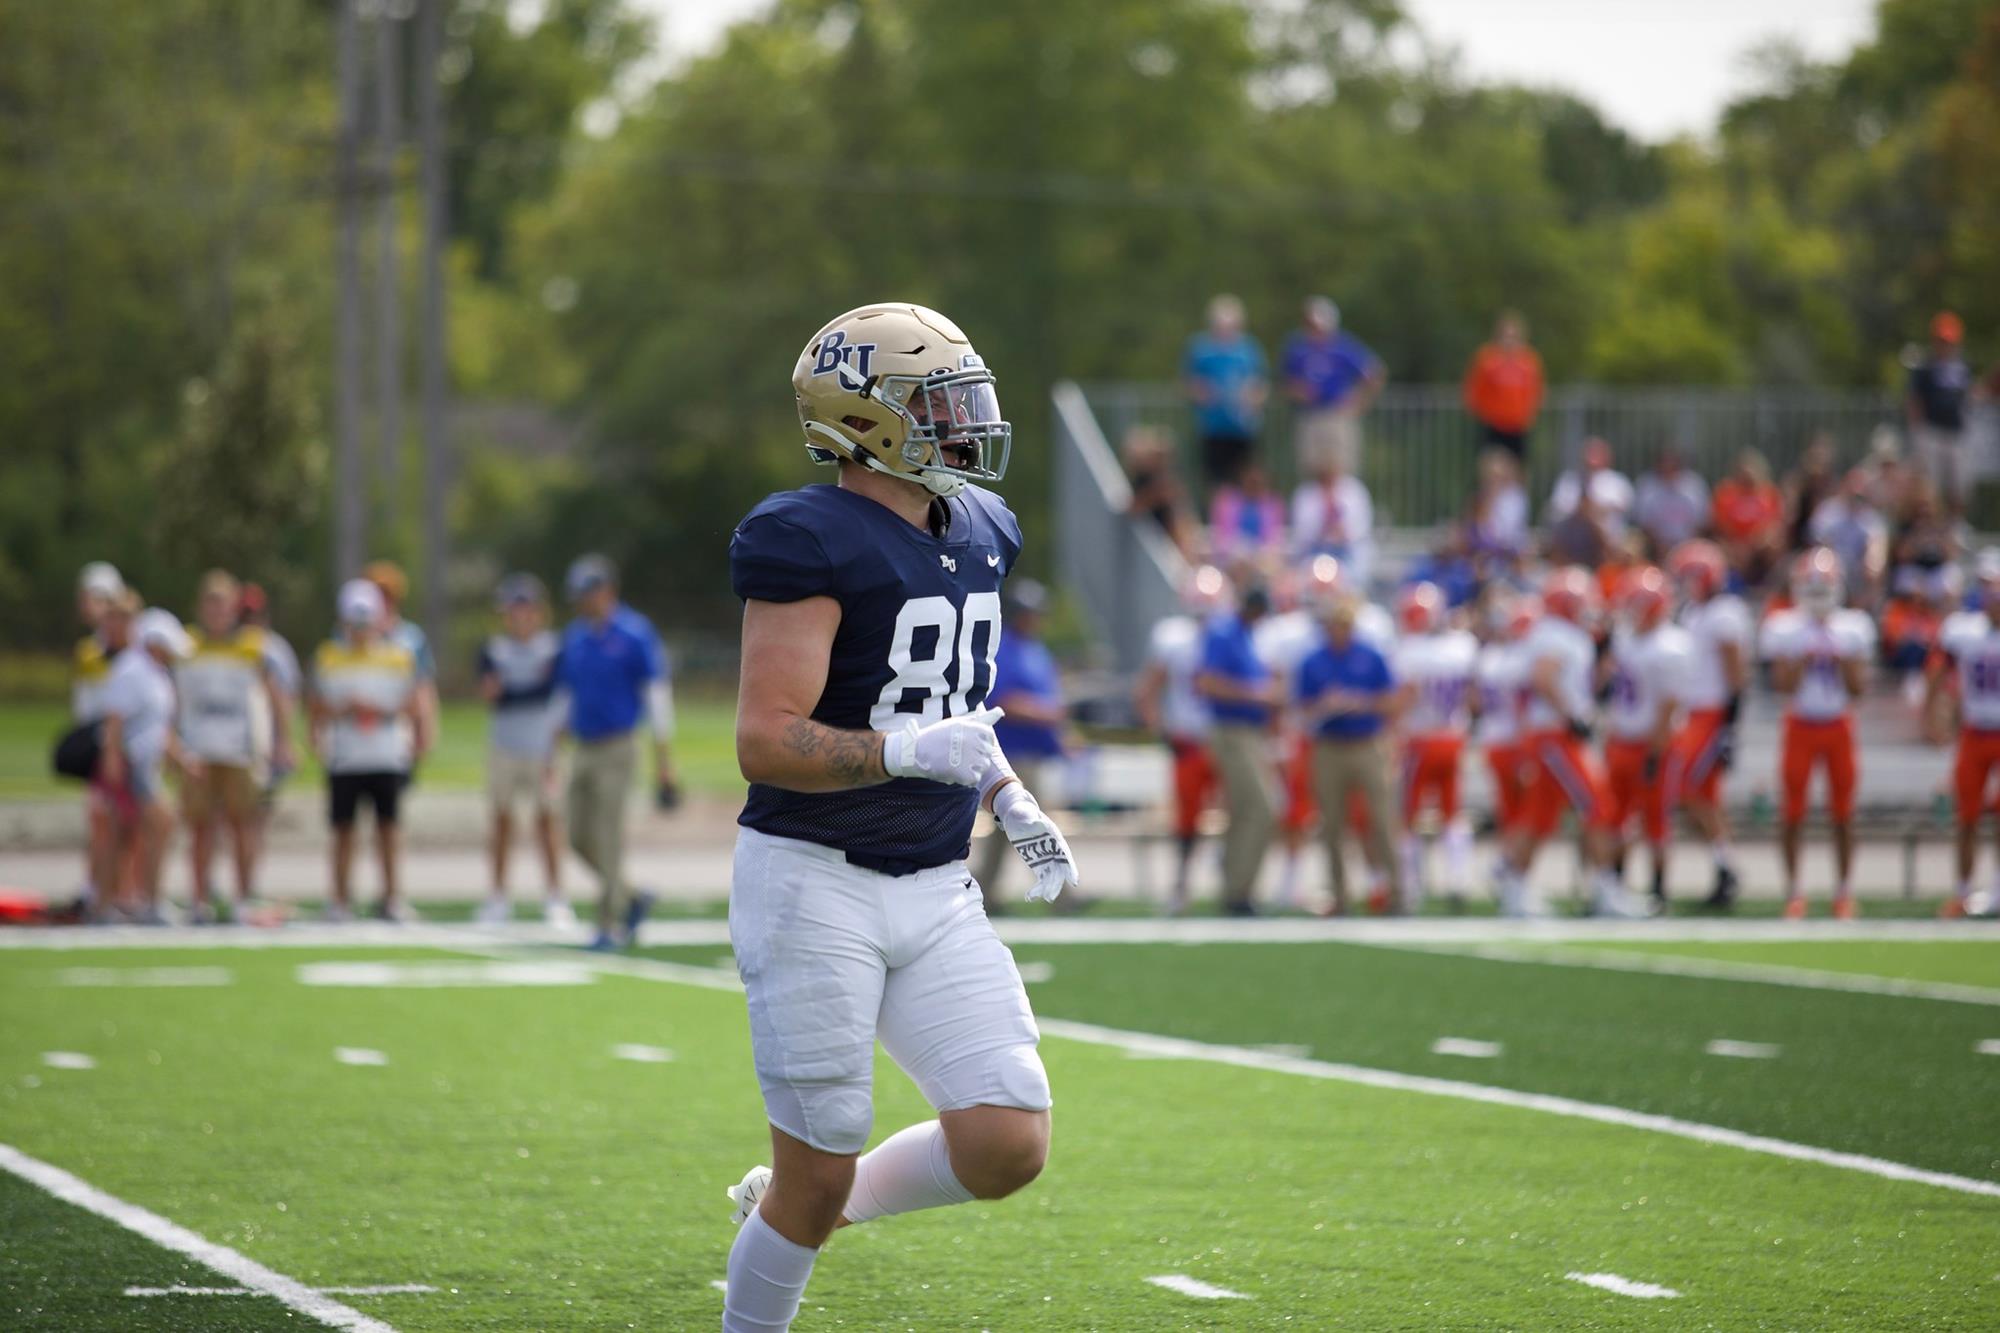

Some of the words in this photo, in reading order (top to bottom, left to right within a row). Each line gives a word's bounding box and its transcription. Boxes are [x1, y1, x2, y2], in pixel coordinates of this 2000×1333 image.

[812, 330, 876, 391] BU
[940, 555, 956, 572] BU
[869, 592, 1001, 731] 80
